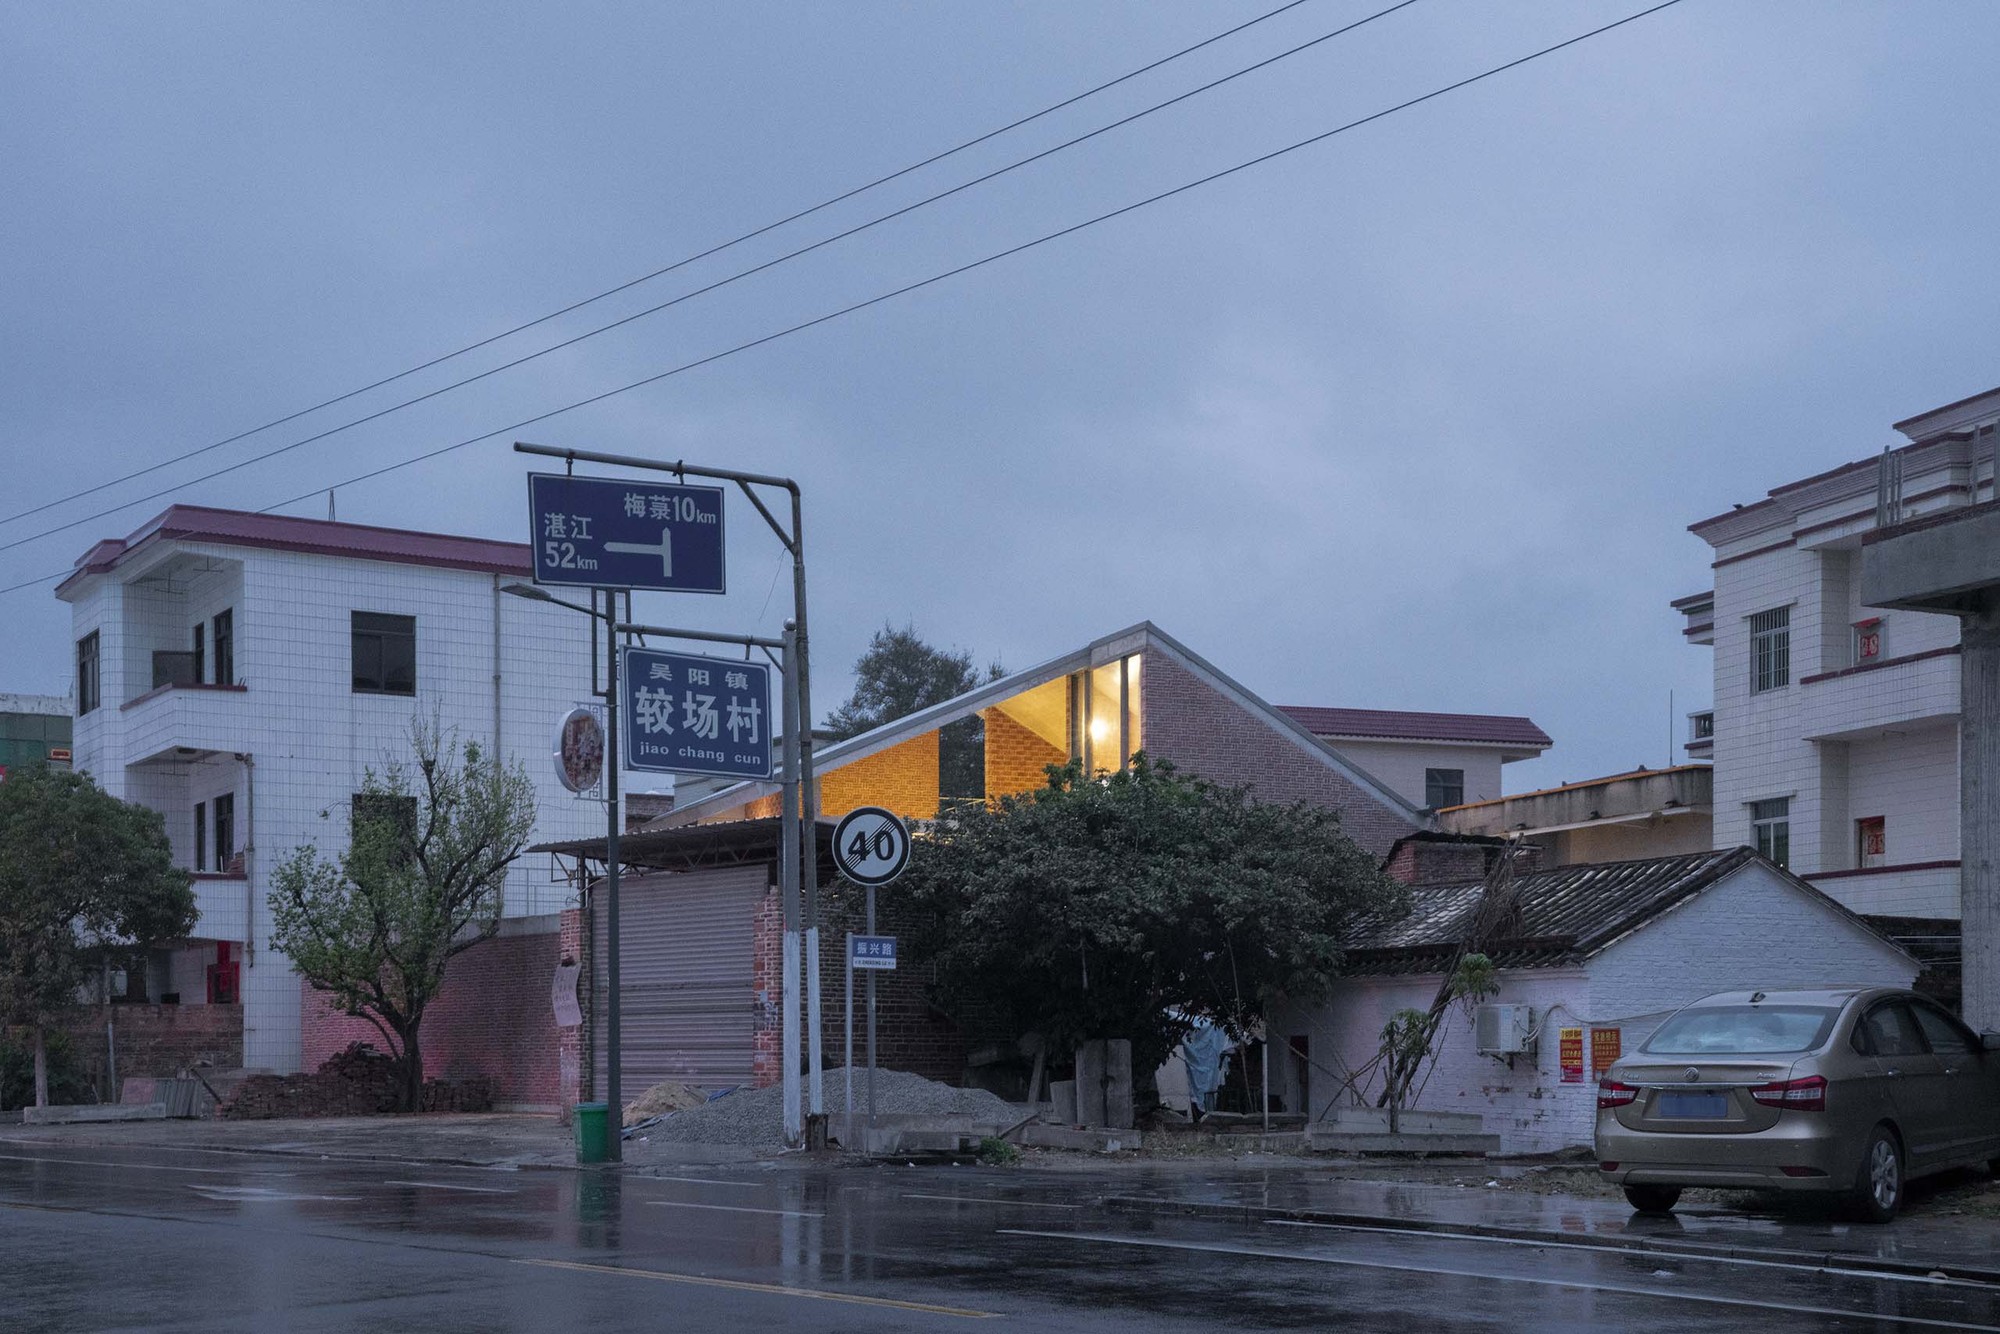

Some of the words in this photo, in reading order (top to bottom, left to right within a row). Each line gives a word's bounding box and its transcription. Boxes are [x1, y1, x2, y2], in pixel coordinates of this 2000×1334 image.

[544, 512, 593, 540] 湛江
[545, 540, 598, 570] 52km
[649, 662, 749, 690] 吴阳镇
[635, 685, 762, 744] 较场村
[639, 741, 669, 755] jiao
[678, 745, 725, 762] chang
[734, 753, 761, 765] cun
[847, 830, 895, 861] 40
[857, 941, 892, 956] 振兴路
